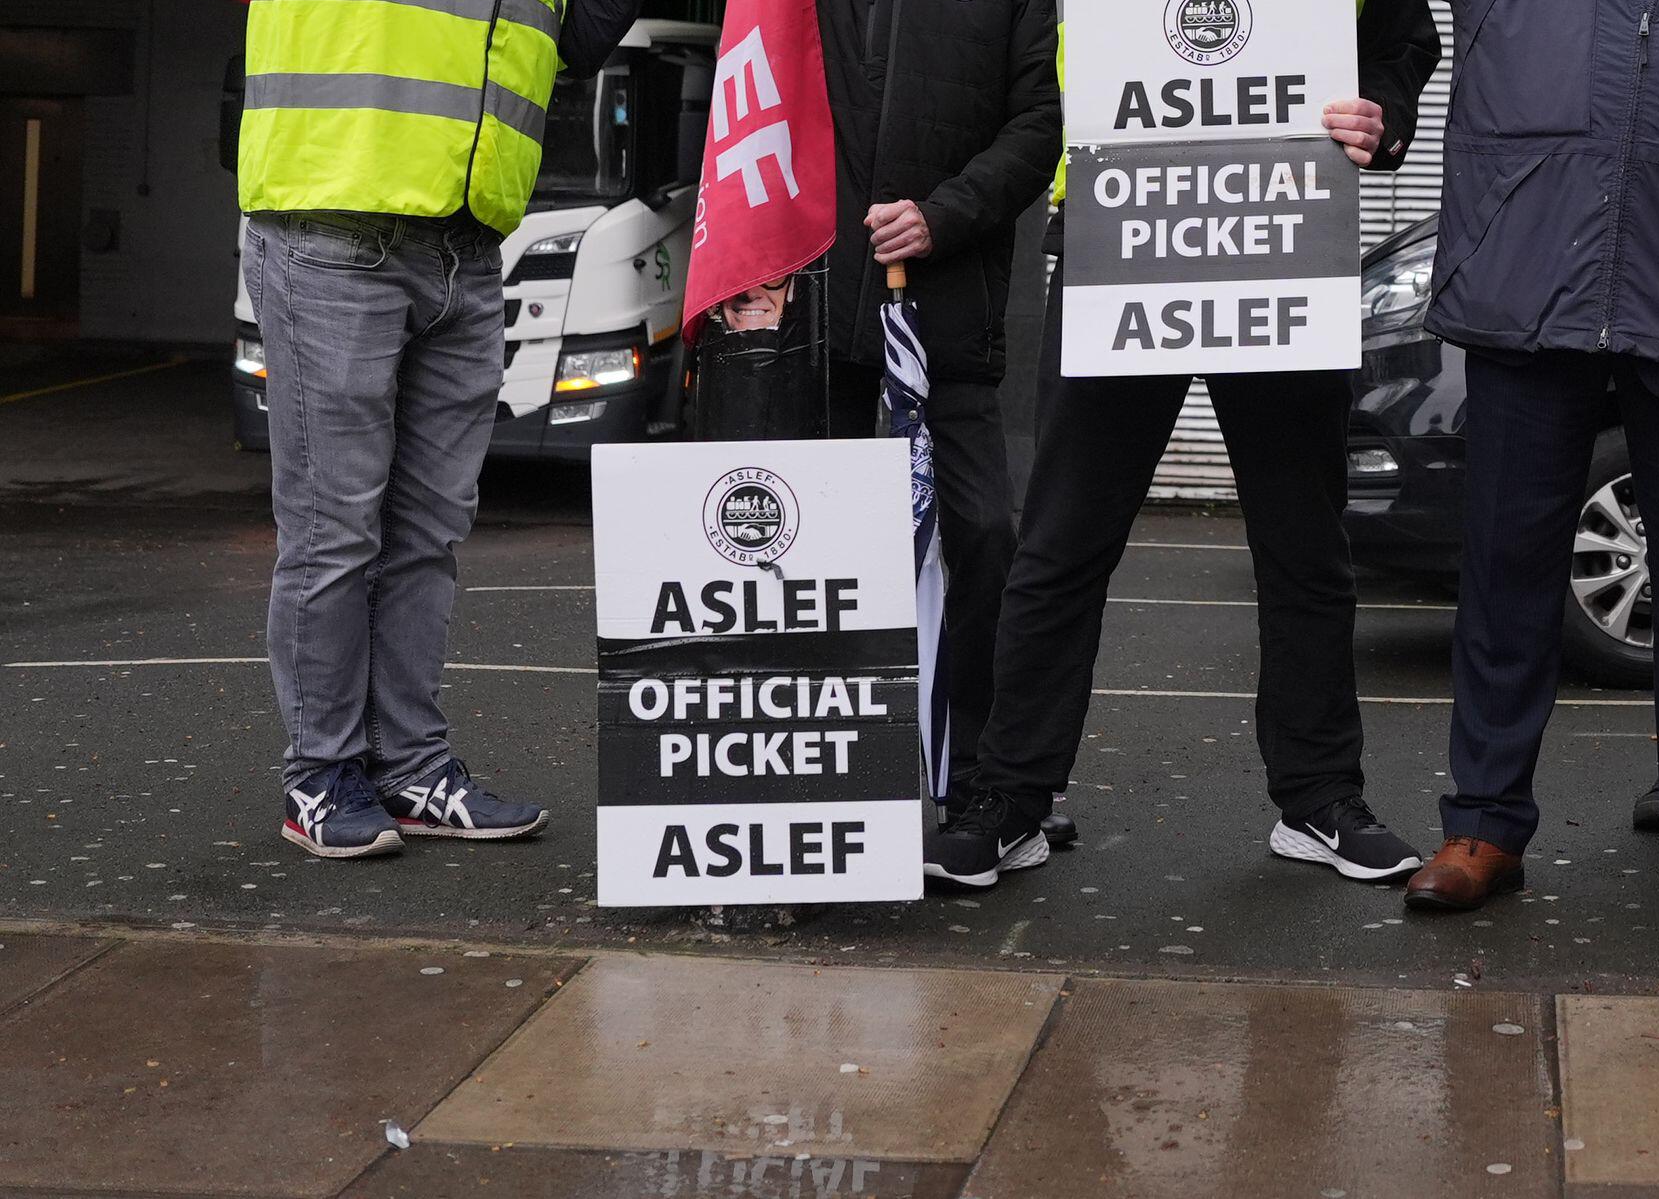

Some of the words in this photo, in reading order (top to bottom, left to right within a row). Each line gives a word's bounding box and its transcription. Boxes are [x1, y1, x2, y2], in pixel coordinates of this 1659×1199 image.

[1219, 34, 1246, 58] 1880
[1113, 75, 1305, 130] ASLEF
[1093, 162, 1330, 208] OFFICIAL
[1121, 214, 1304, 259] PICKET
[1112, 297, 1308, 351] ASLEF
[729, 471, 773, 485] ASLEF
[764, 533, 791, 559] 1880
[650, 578, 858, 634] ASLEF
[628, 677, 887, 720] OFFICIAL
[659, 730, 859, 777] PICKET
[652, 821, 866, 878] ASLEF
